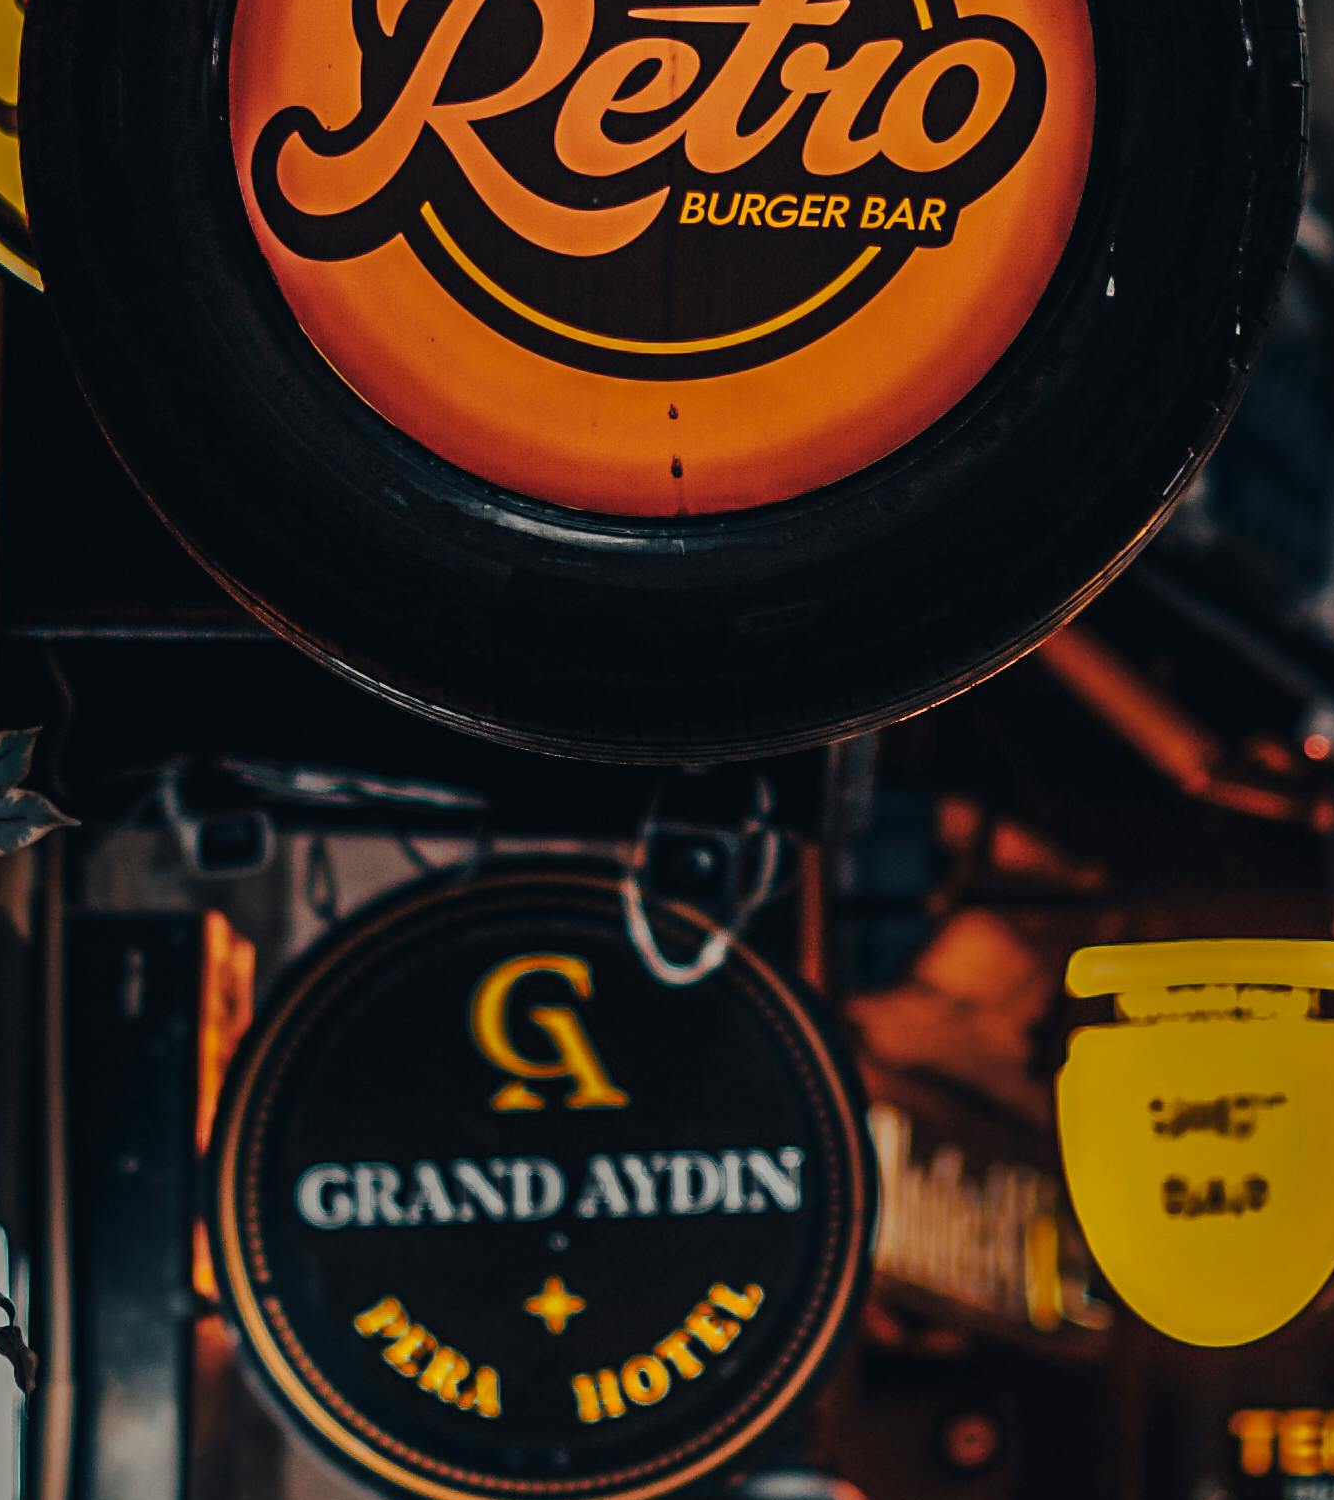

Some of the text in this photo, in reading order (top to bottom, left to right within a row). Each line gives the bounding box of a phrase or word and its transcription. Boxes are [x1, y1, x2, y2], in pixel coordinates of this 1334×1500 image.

[678, 190, 948, 232] BURGER BAR
[296, 1146, 805, 1229] GRAND AYDIN
[353, 1281, 765, 1424] PERA HOTEL
